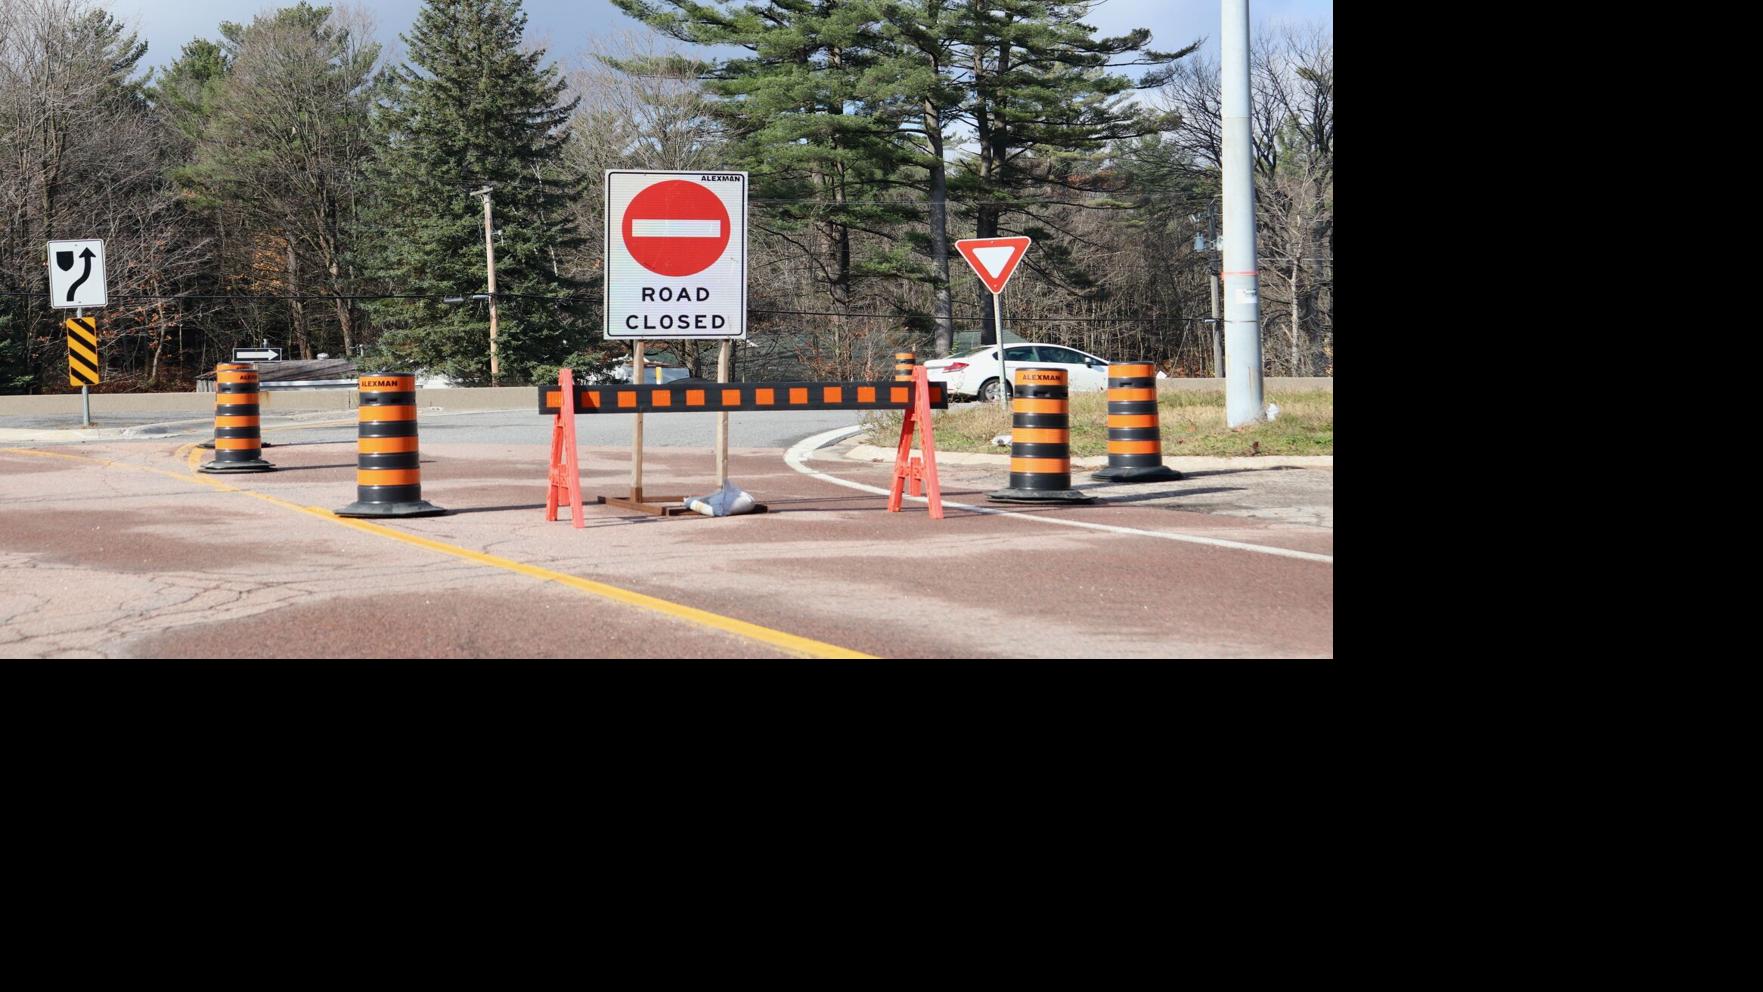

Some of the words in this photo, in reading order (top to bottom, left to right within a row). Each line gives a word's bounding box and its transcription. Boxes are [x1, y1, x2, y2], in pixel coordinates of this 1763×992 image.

[701, 175, 740, 183] ALEXMAN
[642, 287, 710, 302] ROAD
[626, 314, 725, 330] CLOSED
